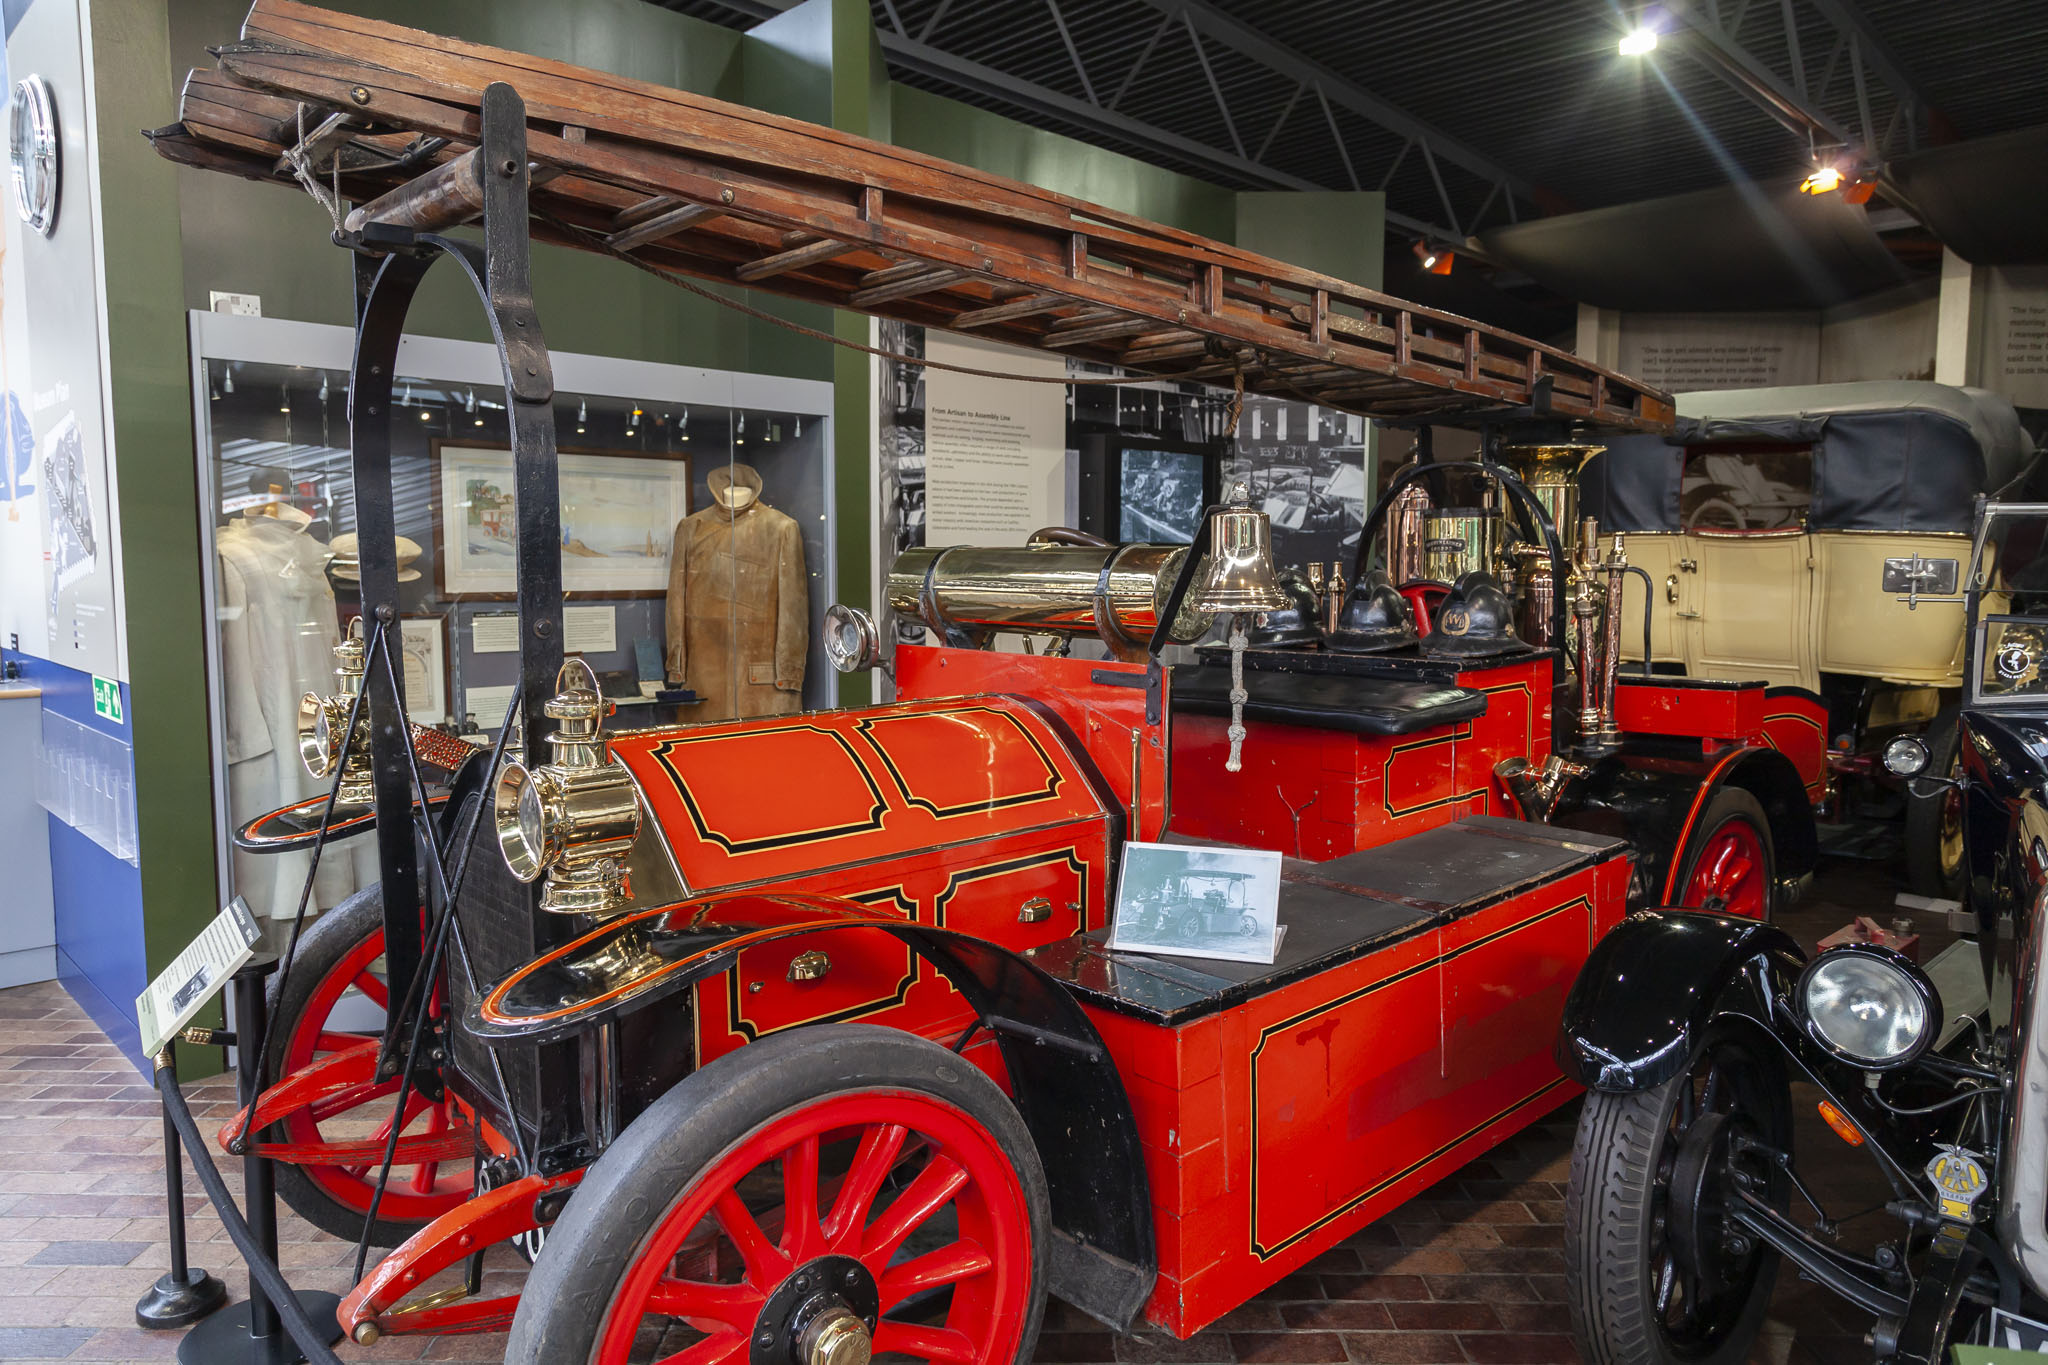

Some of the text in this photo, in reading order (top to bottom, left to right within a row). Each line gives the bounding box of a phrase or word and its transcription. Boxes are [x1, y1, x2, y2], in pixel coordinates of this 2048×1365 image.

[932, 406, 946, 415] From
[947, 408, 967, 417] Artisan
[975, 411, 999, 421] Assembly
